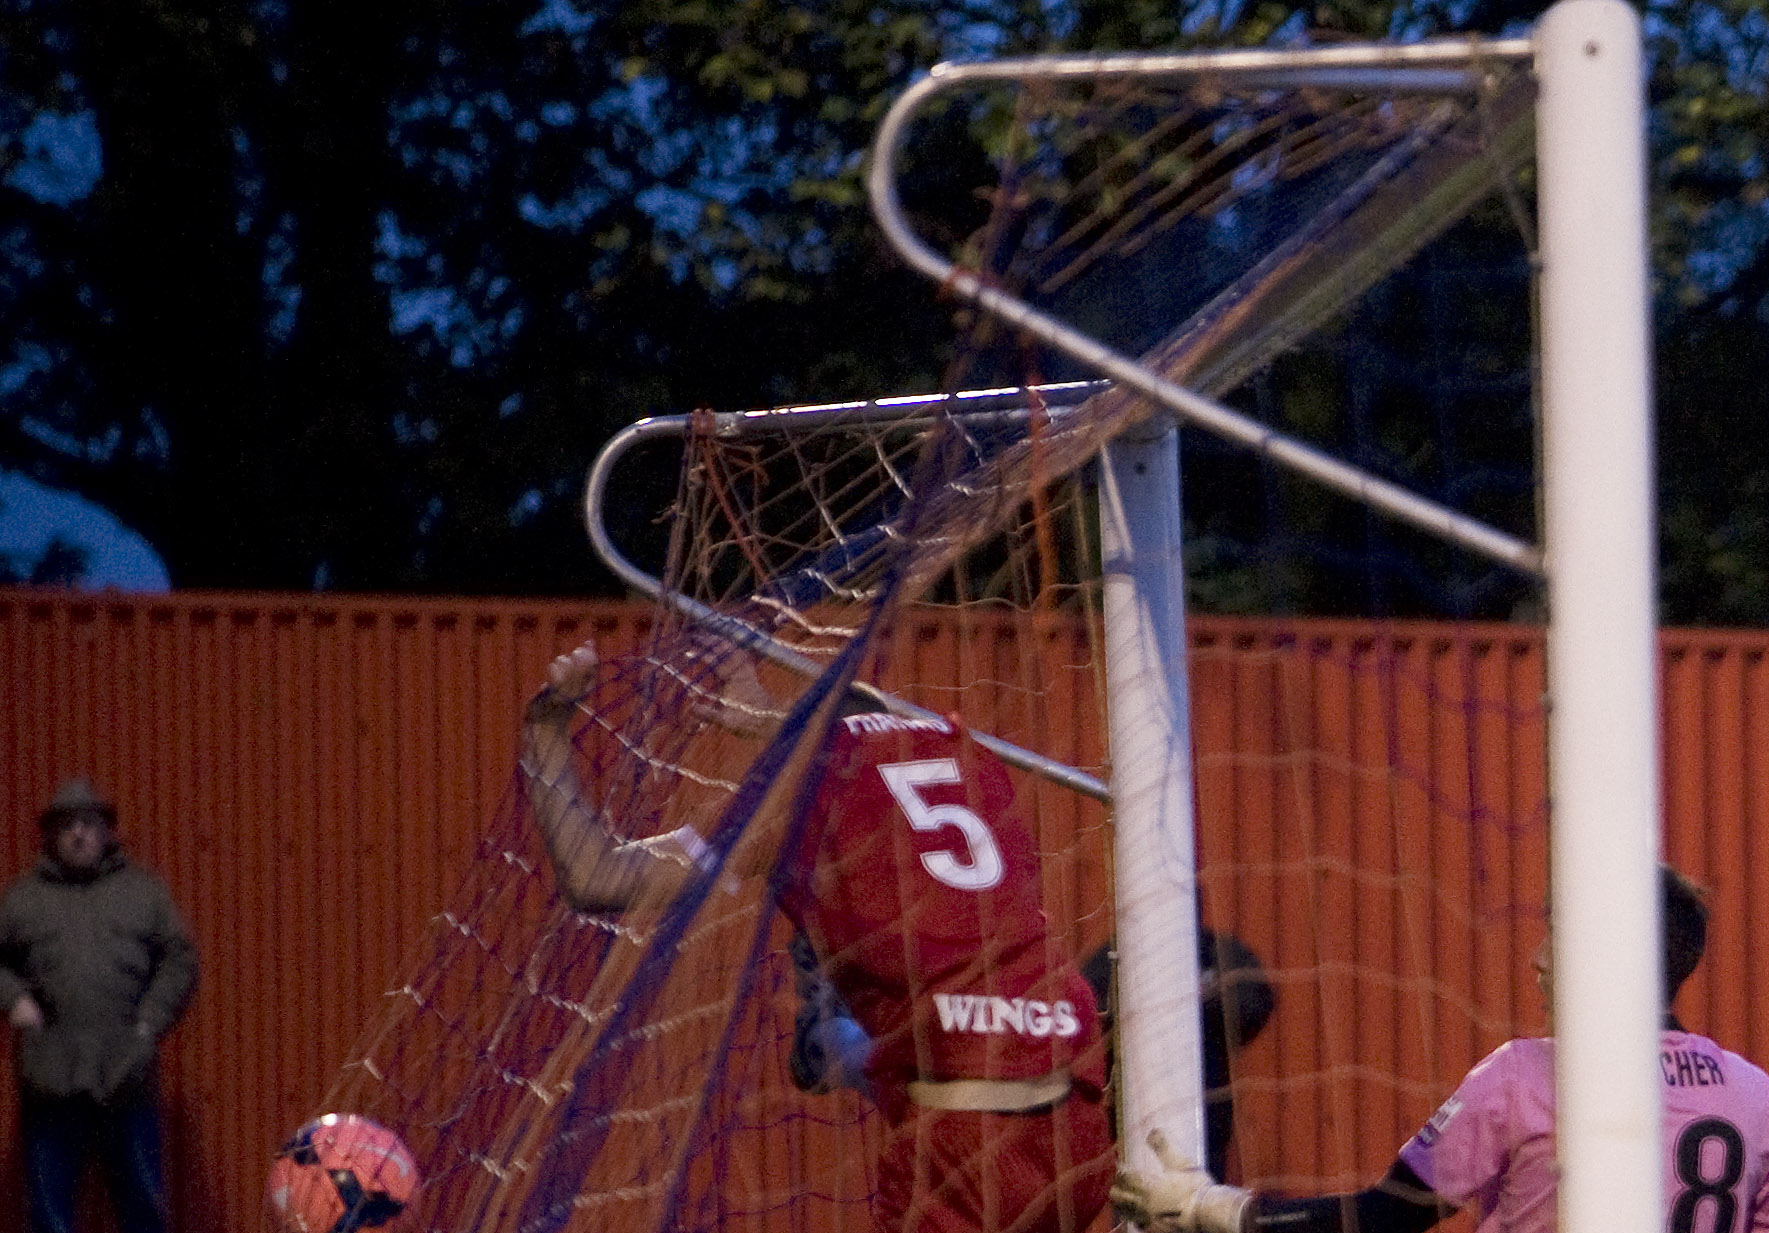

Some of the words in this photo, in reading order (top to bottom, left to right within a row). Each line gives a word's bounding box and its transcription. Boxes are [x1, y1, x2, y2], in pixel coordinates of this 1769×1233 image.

[877, 757, 1002, 892] 5
[932, 993, 1080, 1038] WINGS
[1659, 1049, 1726, 1087] CHER
